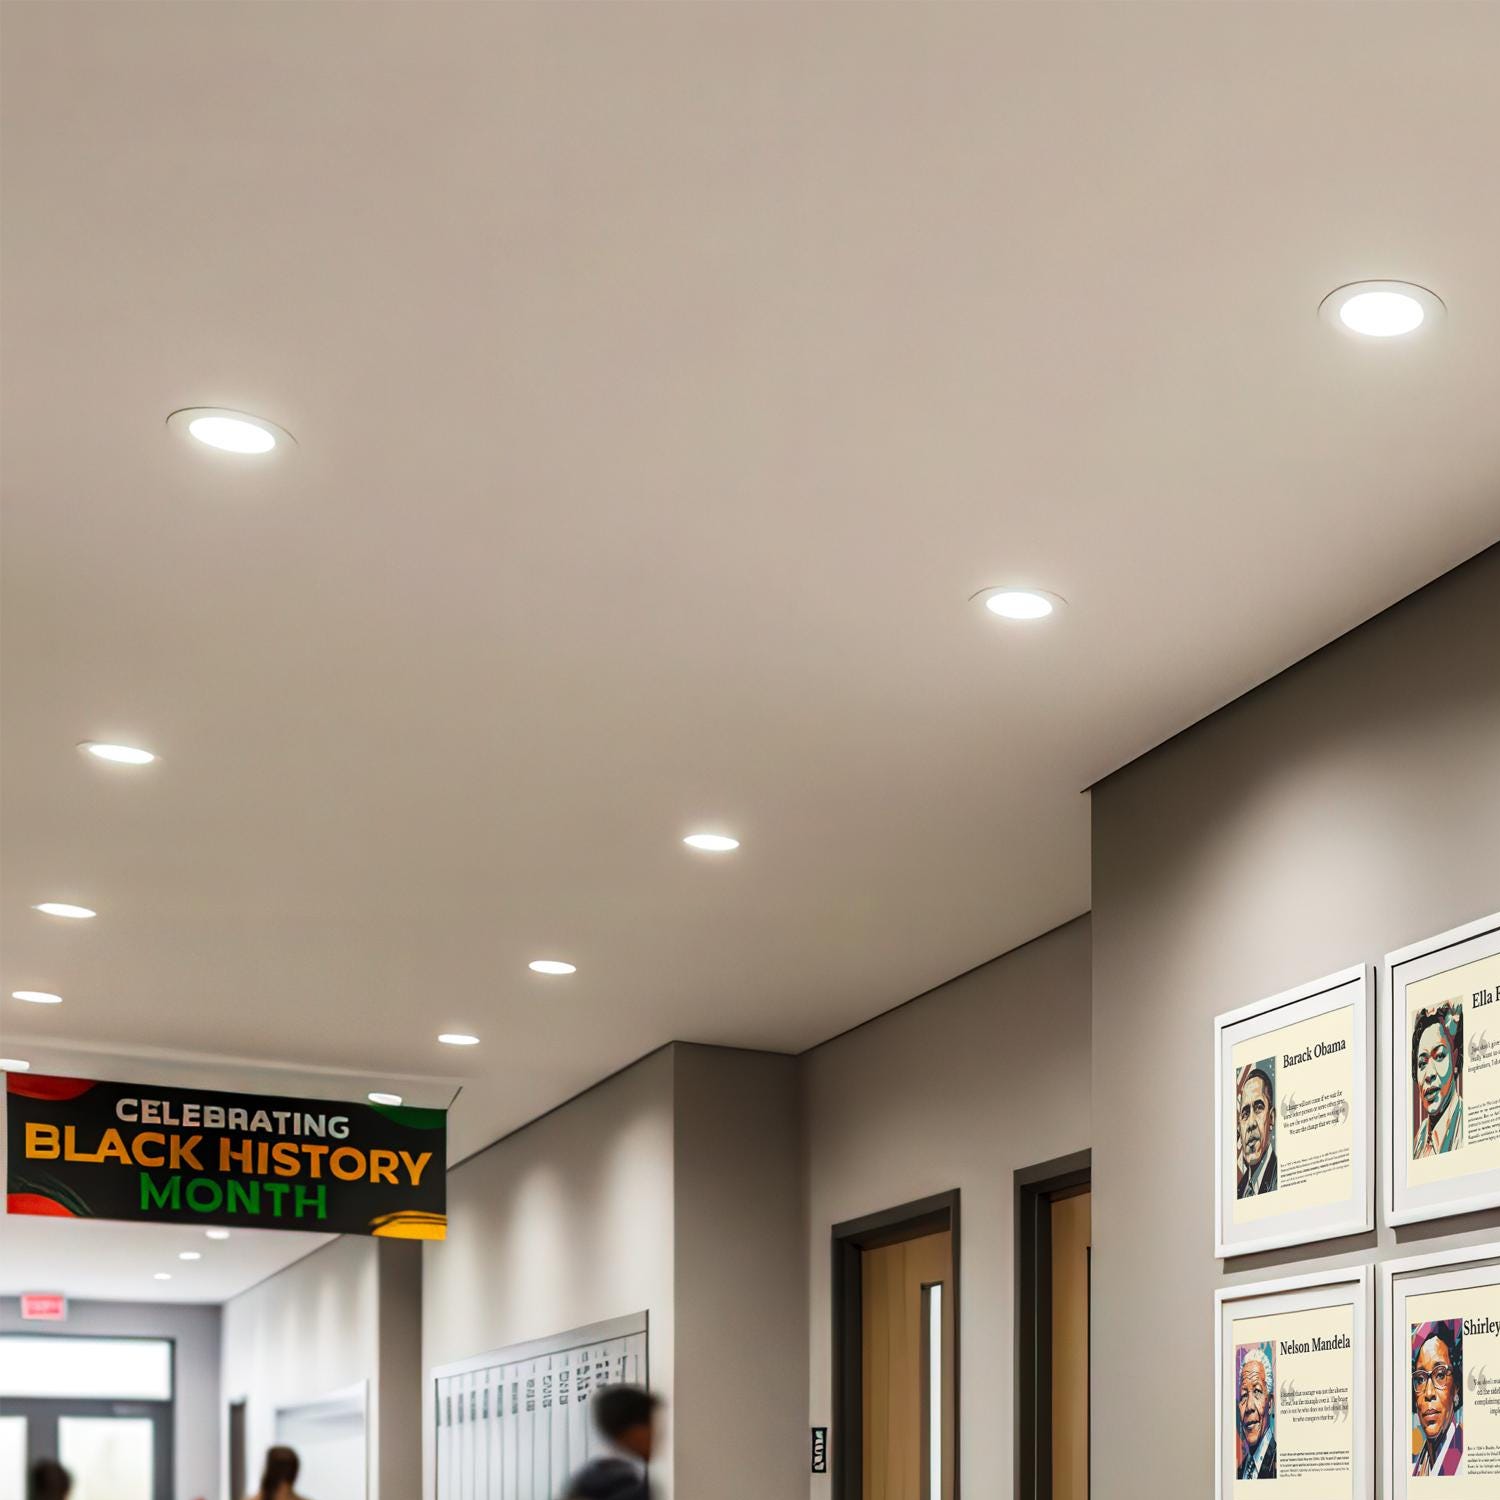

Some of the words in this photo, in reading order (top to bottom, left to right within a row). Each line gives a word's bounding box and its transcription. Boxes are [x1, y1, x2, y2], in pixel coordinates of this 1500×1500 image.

[1472, 989, 1492, 1008] Ella
[1283, 1047, 1312, 1068] Barack
[1313, 1039, 1346, 1058] Obama
[116, 1098, 349, 1139] CELEBRATING
[25, 1122, 203, 1170] BLACK
[219, 1137, 432, 1186] HISTORY
[140, 1172, 327, 1219] MONTH
[1280, 1339, 1309, 1355] Nelson
[1312, 1333, 1350, 1352] Mandela
